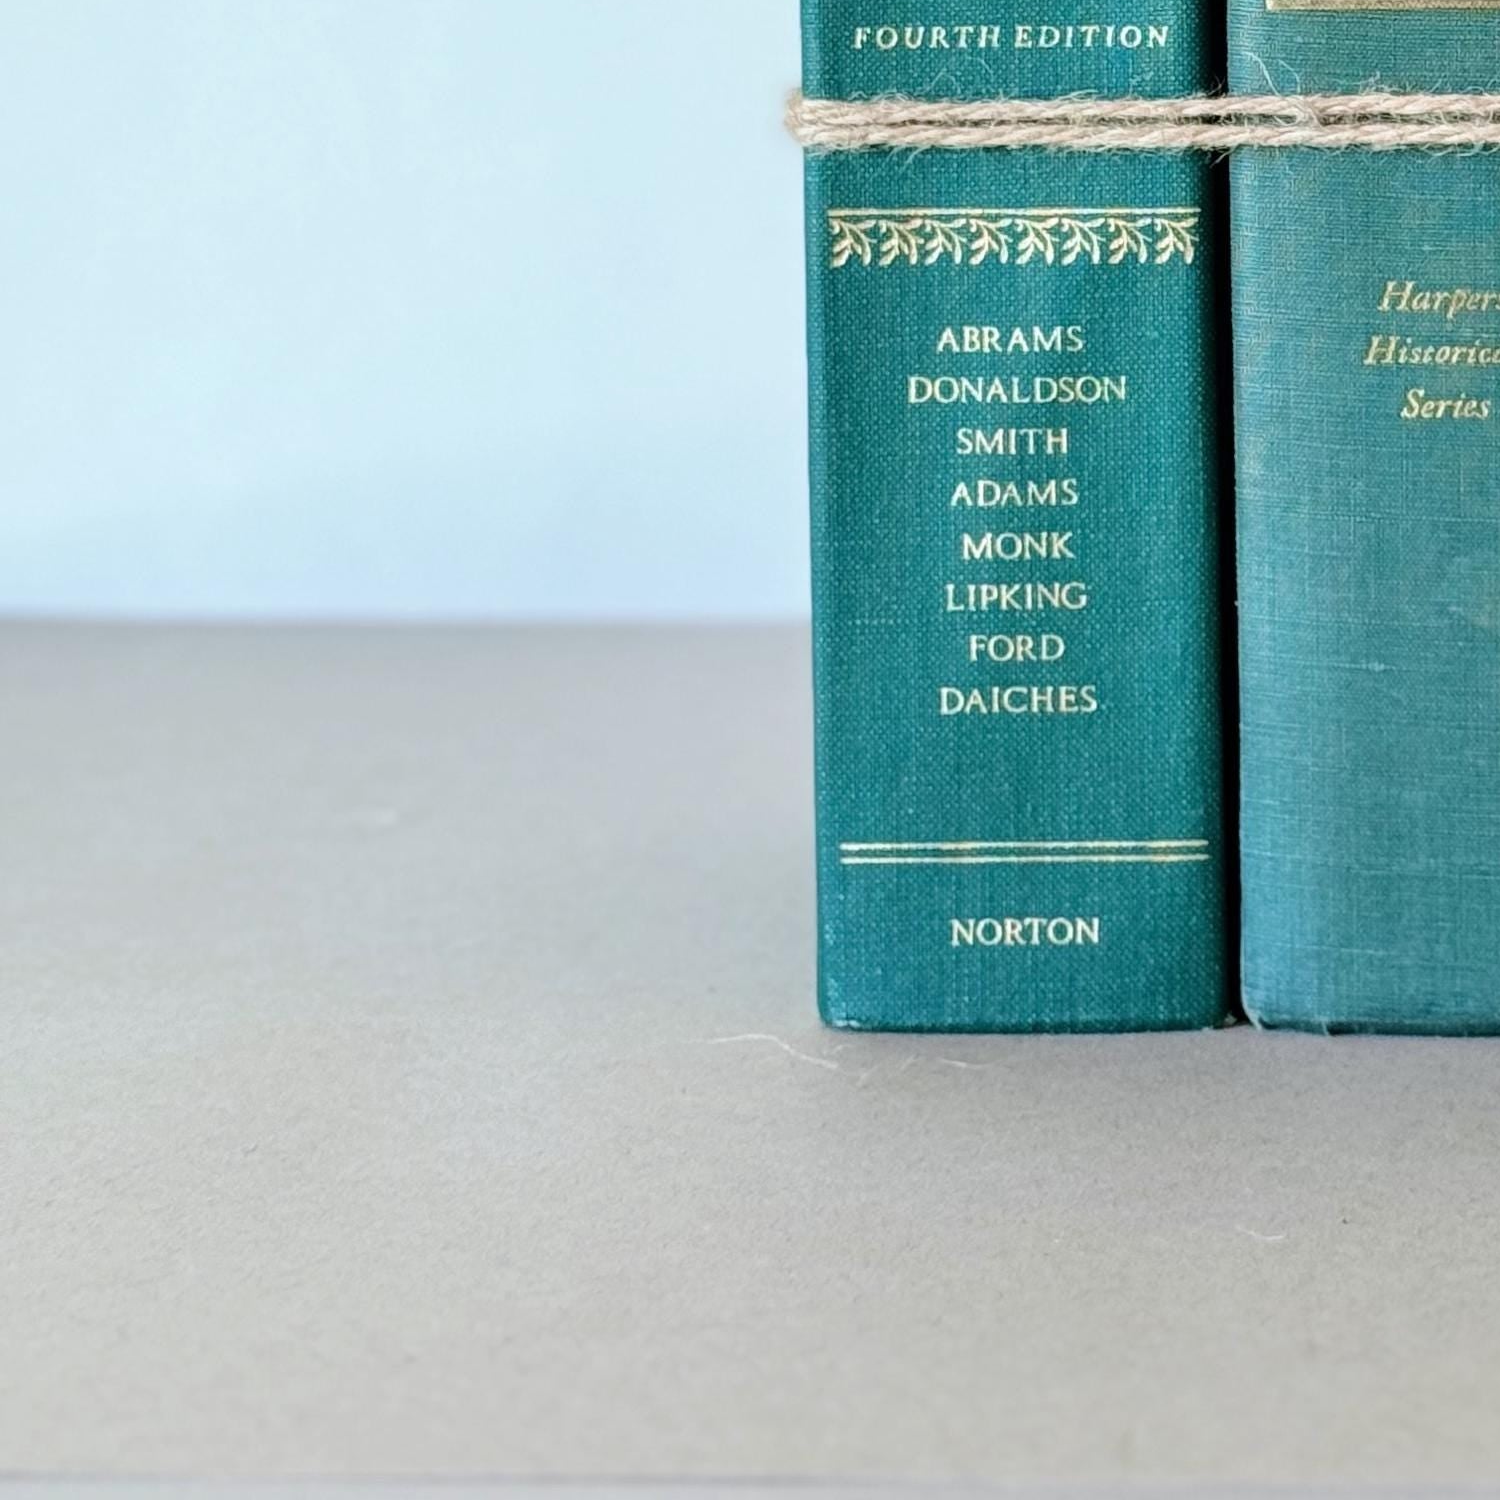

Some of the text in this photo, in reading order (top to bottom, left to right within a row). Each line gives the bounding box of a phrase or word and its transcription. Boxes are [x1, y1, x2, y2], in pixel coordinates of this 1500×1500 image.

[853, 25, 1169, 50] FOURTH EDITION
[936, 325, 1084, 354] ABRAMS
[907, 375, 1127, 405] DONALDSON
[1400, 387, 1492, 420] Series
[956, 427, 1068, 455] SMITH
[950, 478, 1079, 507] ADAMS
[961, 531, 1075, 561] MONK
[945, 581, 1088, 612] LIPKING
[969, 633, 1066, 662] FORD
[939, 685, 1098, 716] DAICHES
[950, 917, 1100, 947] NORTON
